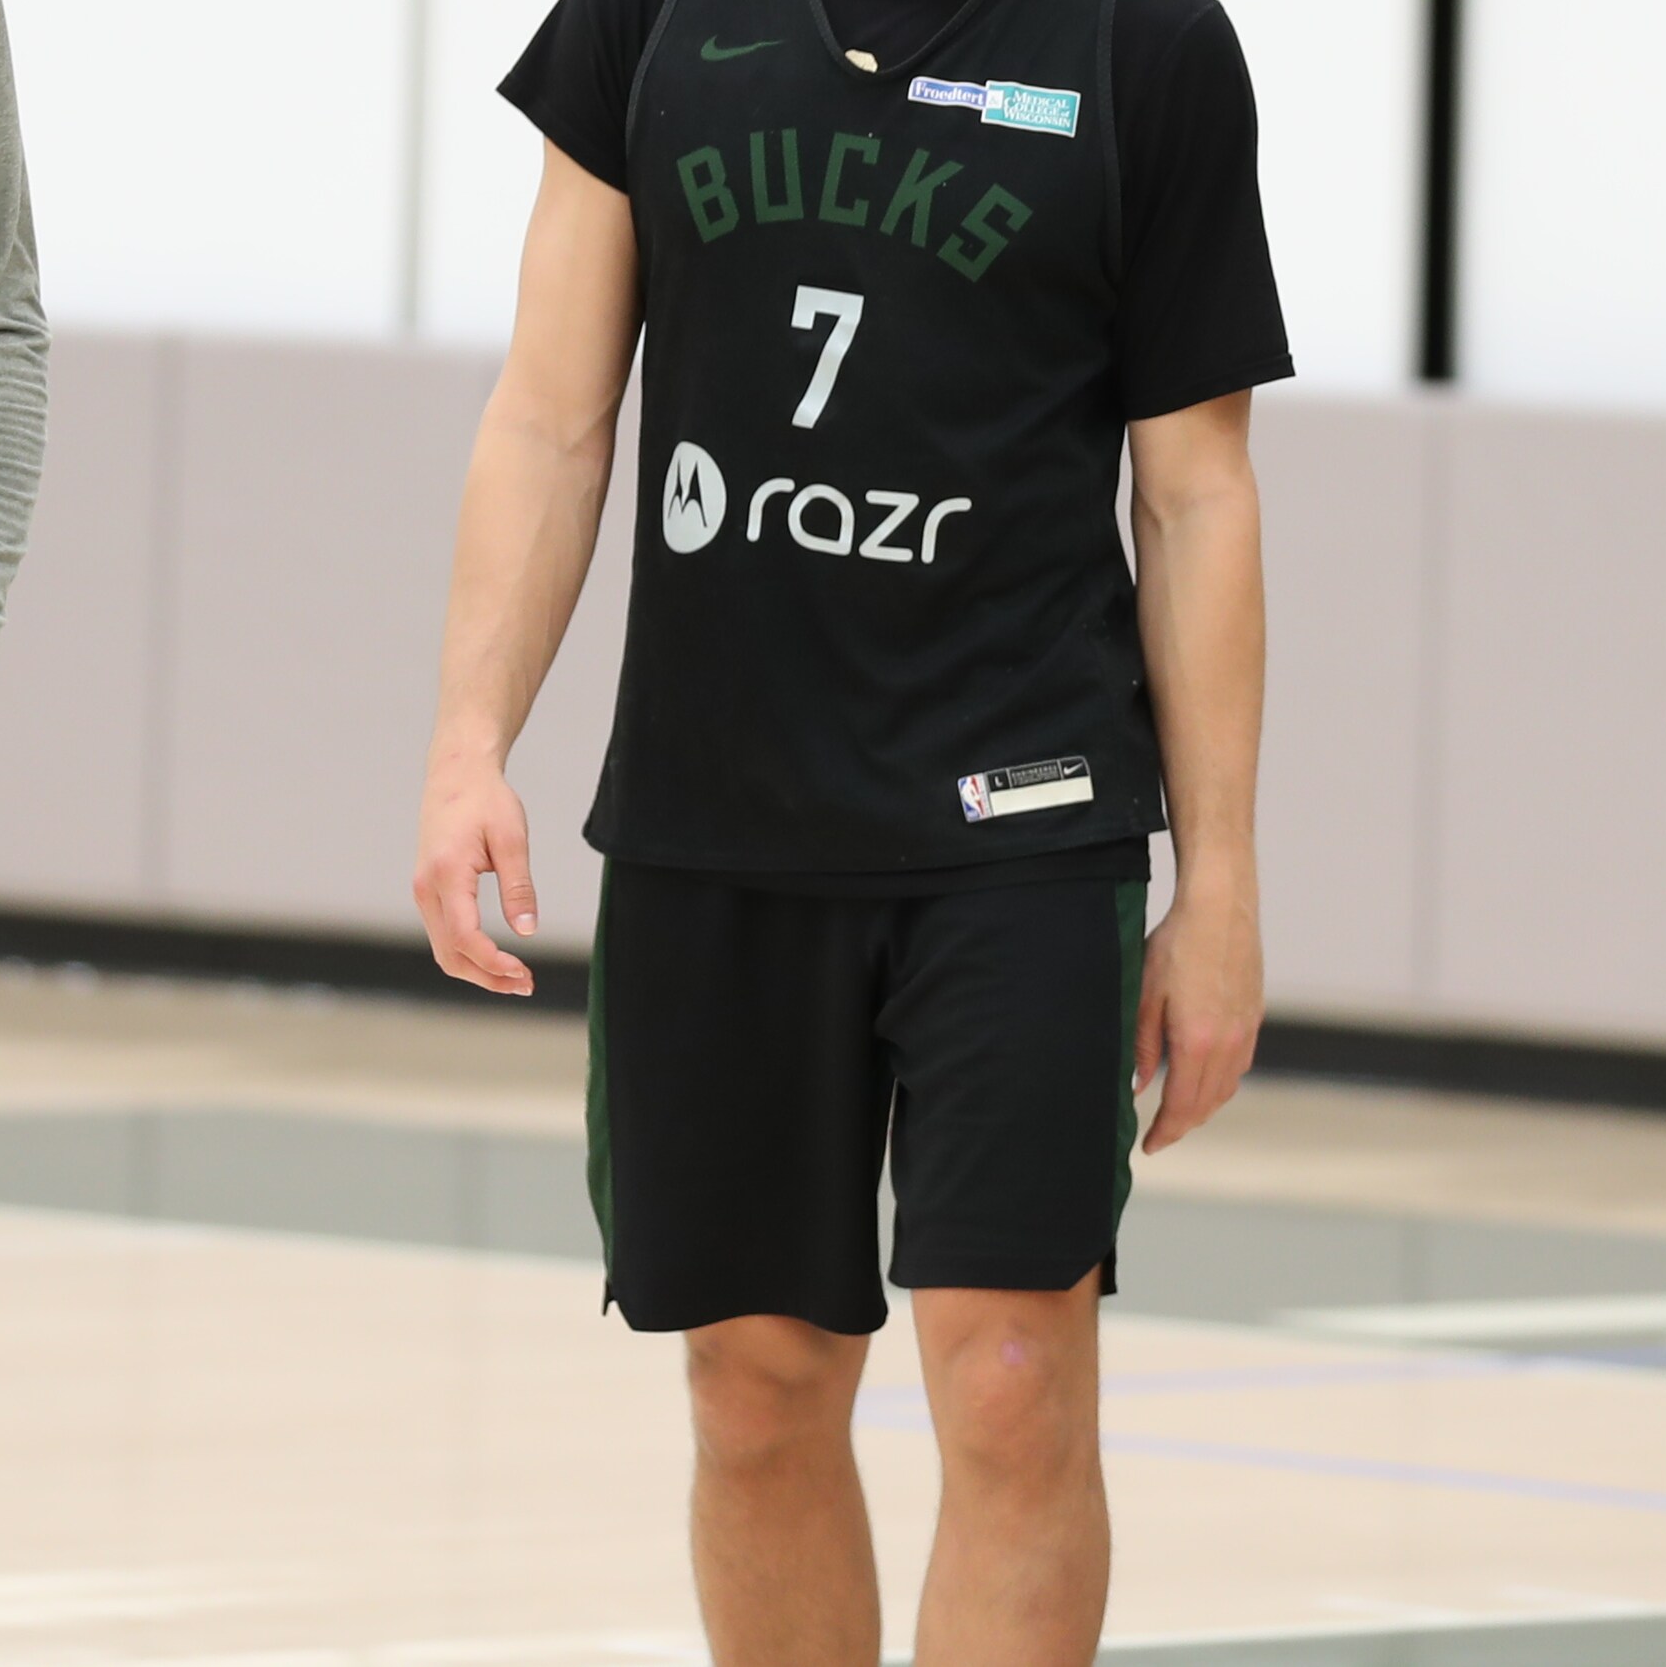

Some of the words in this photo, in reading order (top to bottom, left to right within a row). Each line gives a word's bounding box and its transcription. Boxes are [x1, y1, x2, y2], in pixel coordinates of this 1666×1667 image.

[914, 82, 984, 105] Froedtert
[1013, 90, 1070, 109] MEDICAL
[1003, 106, 1071, 128] WISCONSIN
[1004, 97, 1060, 116] COLLEGE
[677, 128, 1033, 282] BUCKS
[791, 285, 864, 430] 7
[746, 477, 973, 564] razr
